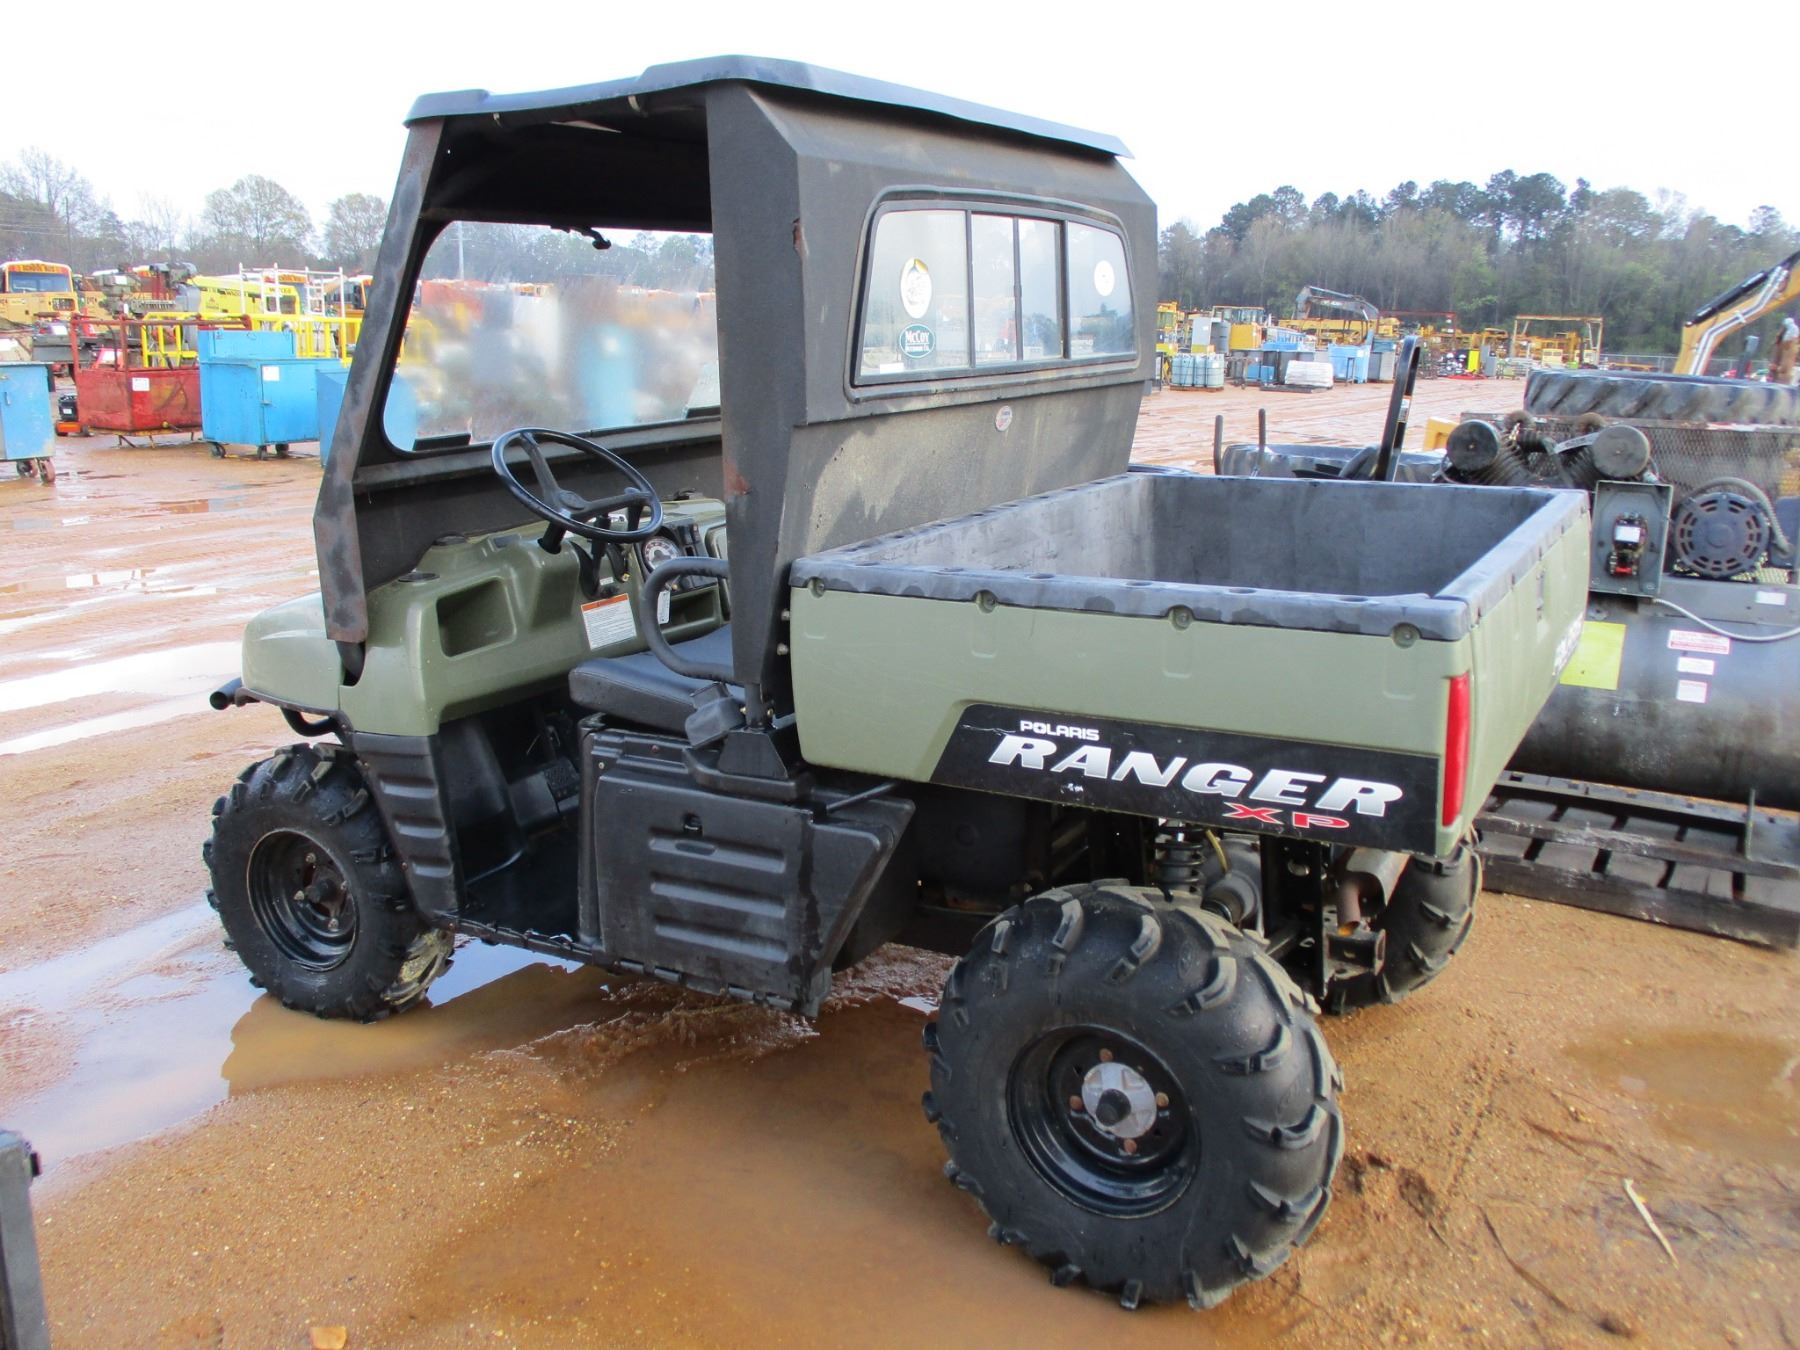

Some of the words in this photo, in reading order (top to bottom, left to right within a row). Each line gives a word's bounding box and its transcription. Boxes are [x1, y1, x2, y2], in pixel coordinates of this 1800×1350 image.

[1020, 720, 1100, 741] POLARIS
[988, 736, 1403, 816] RANGER
[1222, 802, 1350, 829] XP
